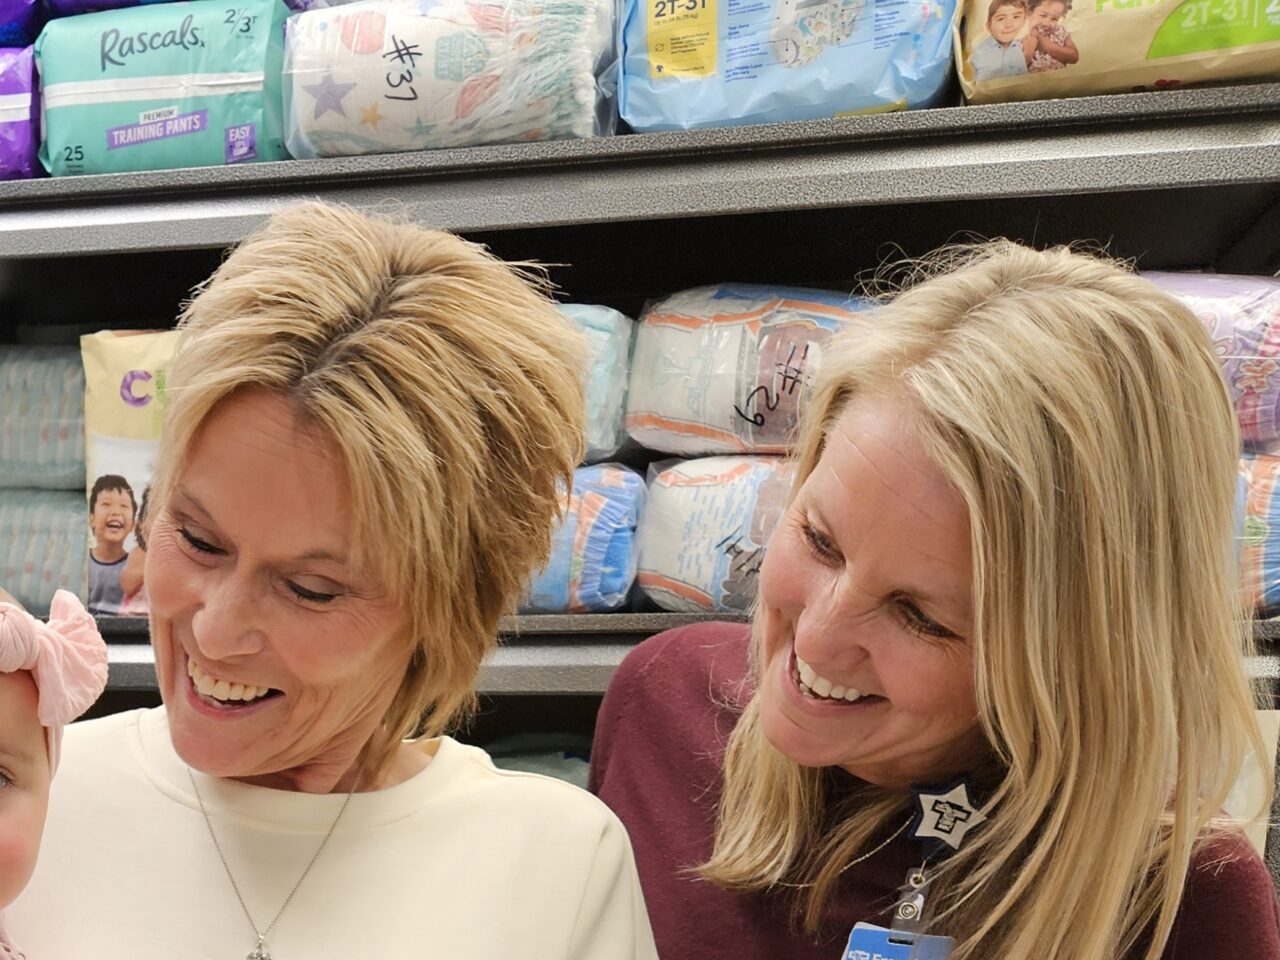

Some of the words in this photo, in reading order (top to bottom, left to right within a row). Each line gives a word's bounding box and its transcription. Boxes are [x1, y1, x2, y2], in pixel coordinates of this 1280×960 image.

[382, 34, 423, 101] #37
[142, 109, 175, 122] PREMIUM
[112, 121, 163, 146] TRAINING
[166, 115, 201, 135] PANTS
[229, 126, 250, 141] EASY
[64, 146, 84, 162] 25
